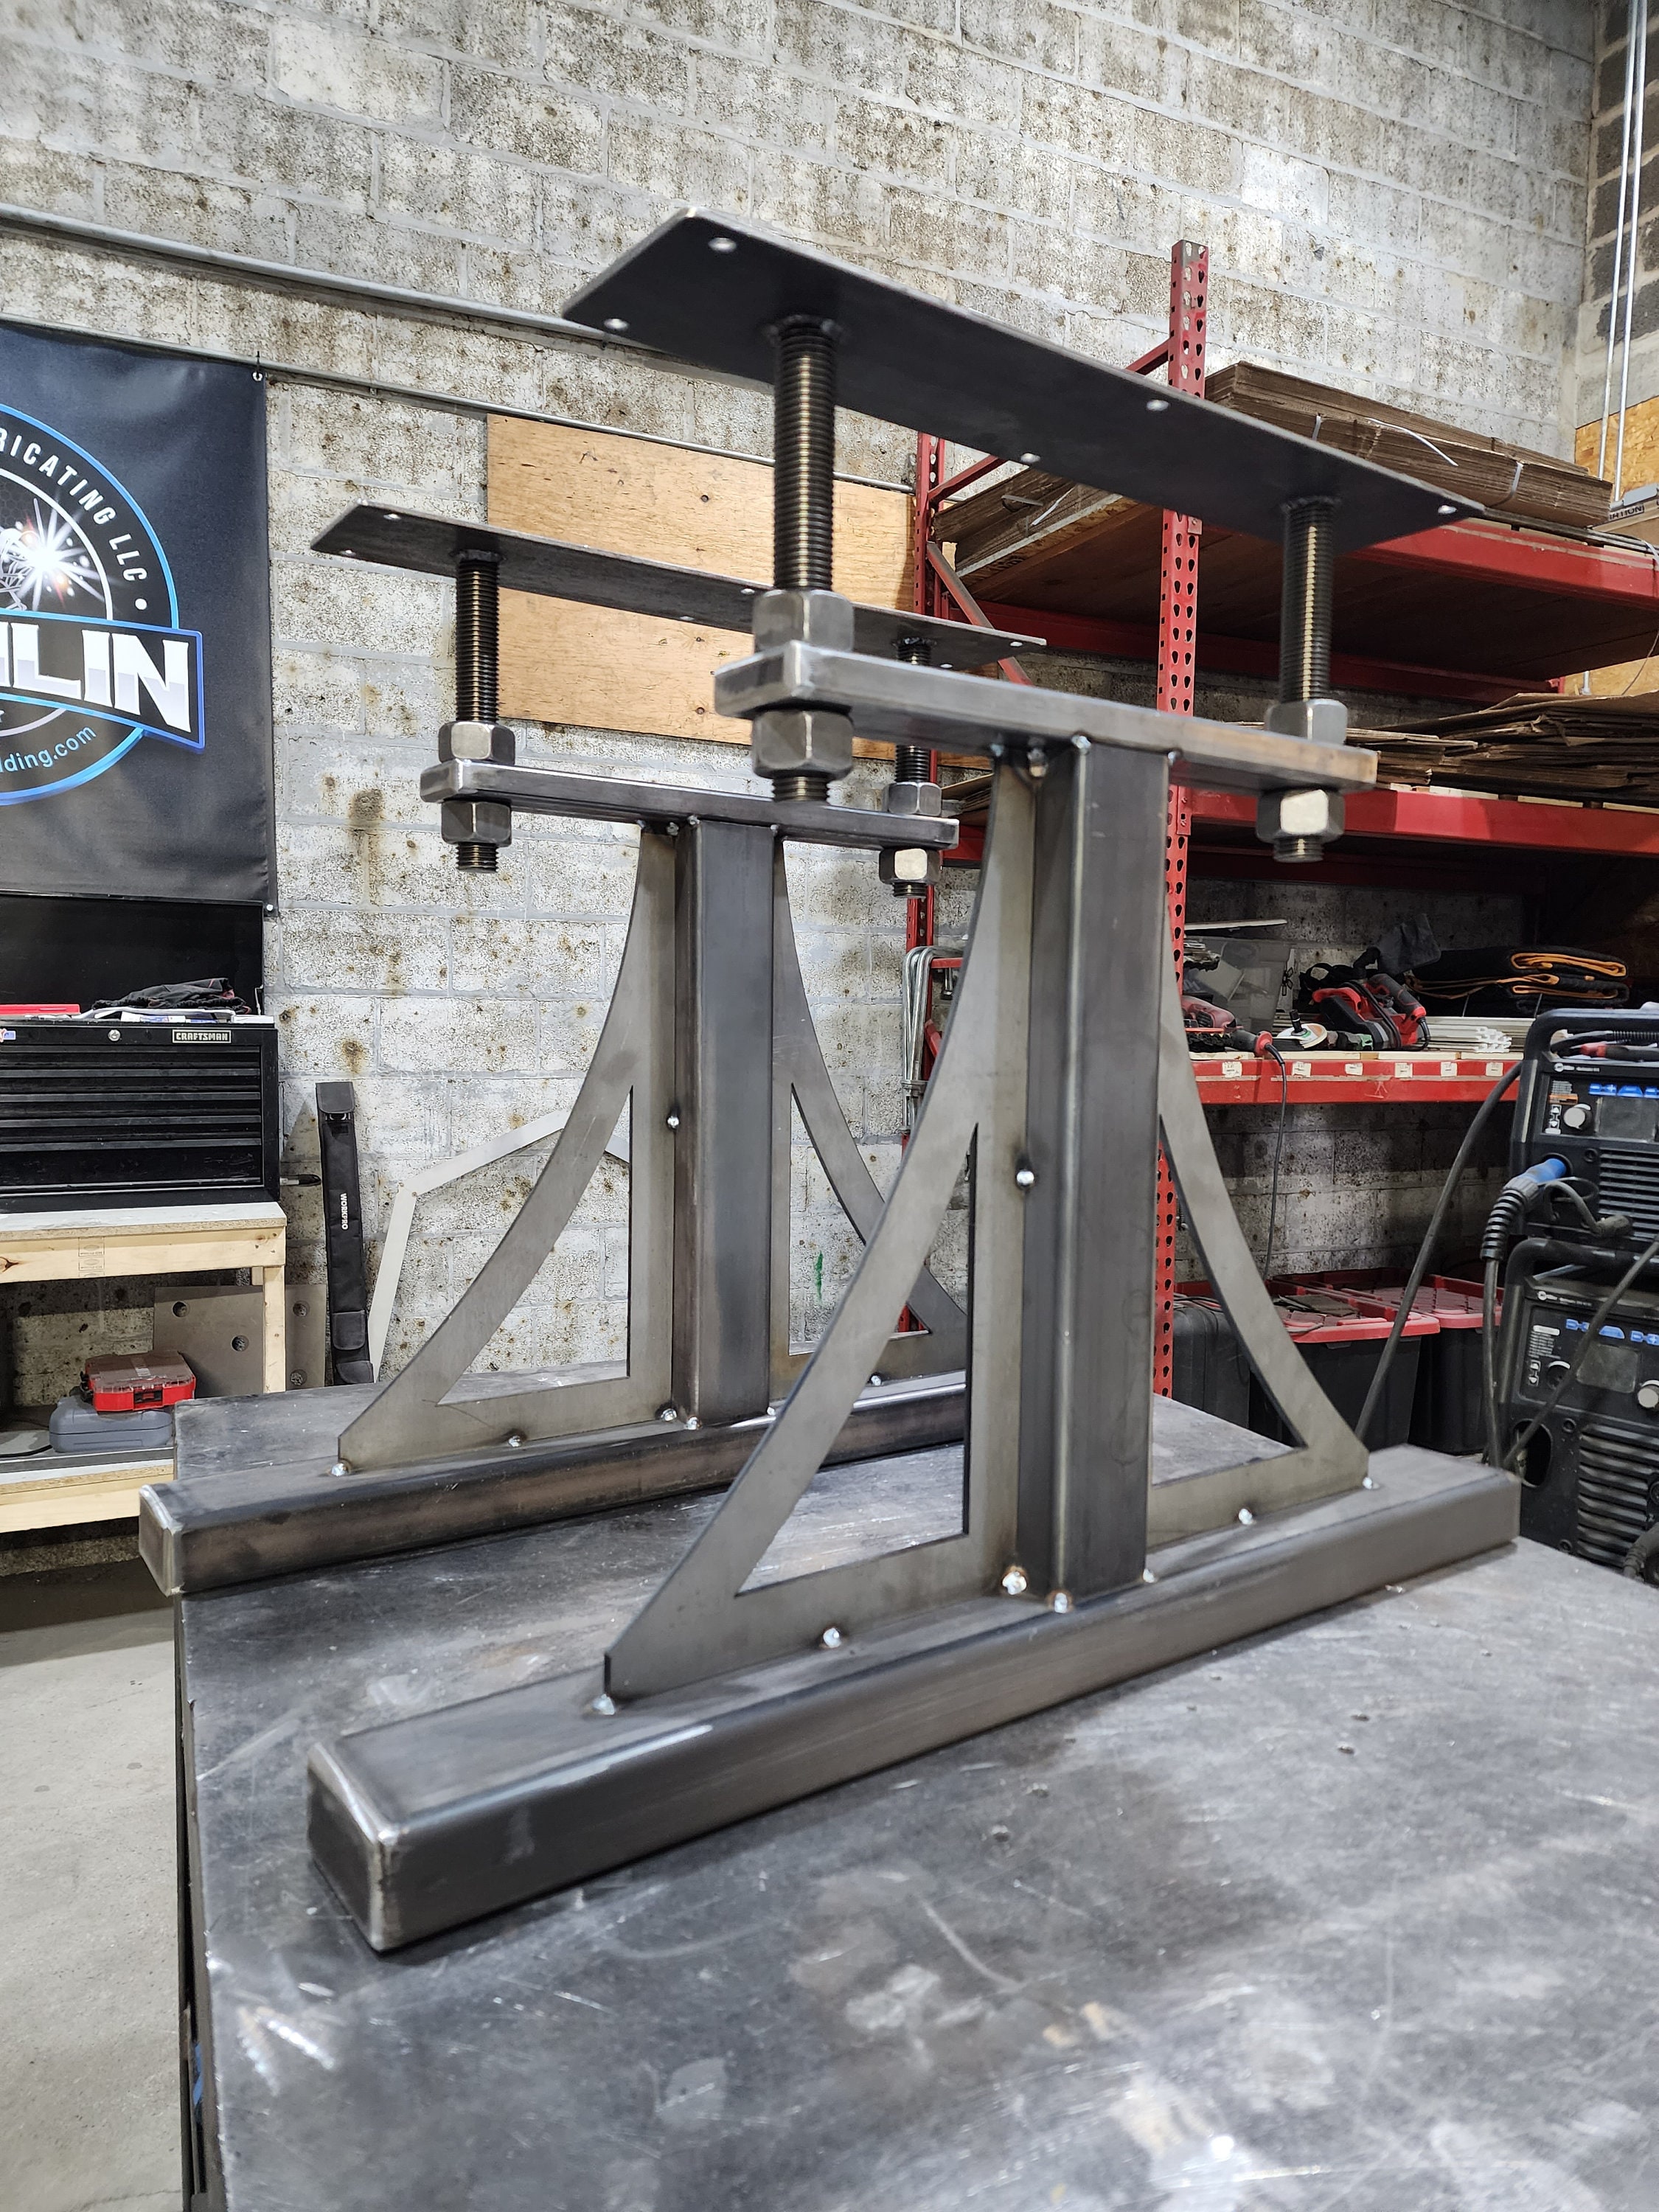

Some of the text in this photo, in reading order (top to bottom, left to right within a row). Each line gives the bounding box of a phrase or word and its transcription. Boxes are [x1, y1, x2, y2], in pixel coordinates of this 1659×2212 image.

[109, 534, 147, 581] LLC
[175, 1032, 228, 1041] CRAFTSMAN
[340, 1193, 349, 1231] WORKPRO
